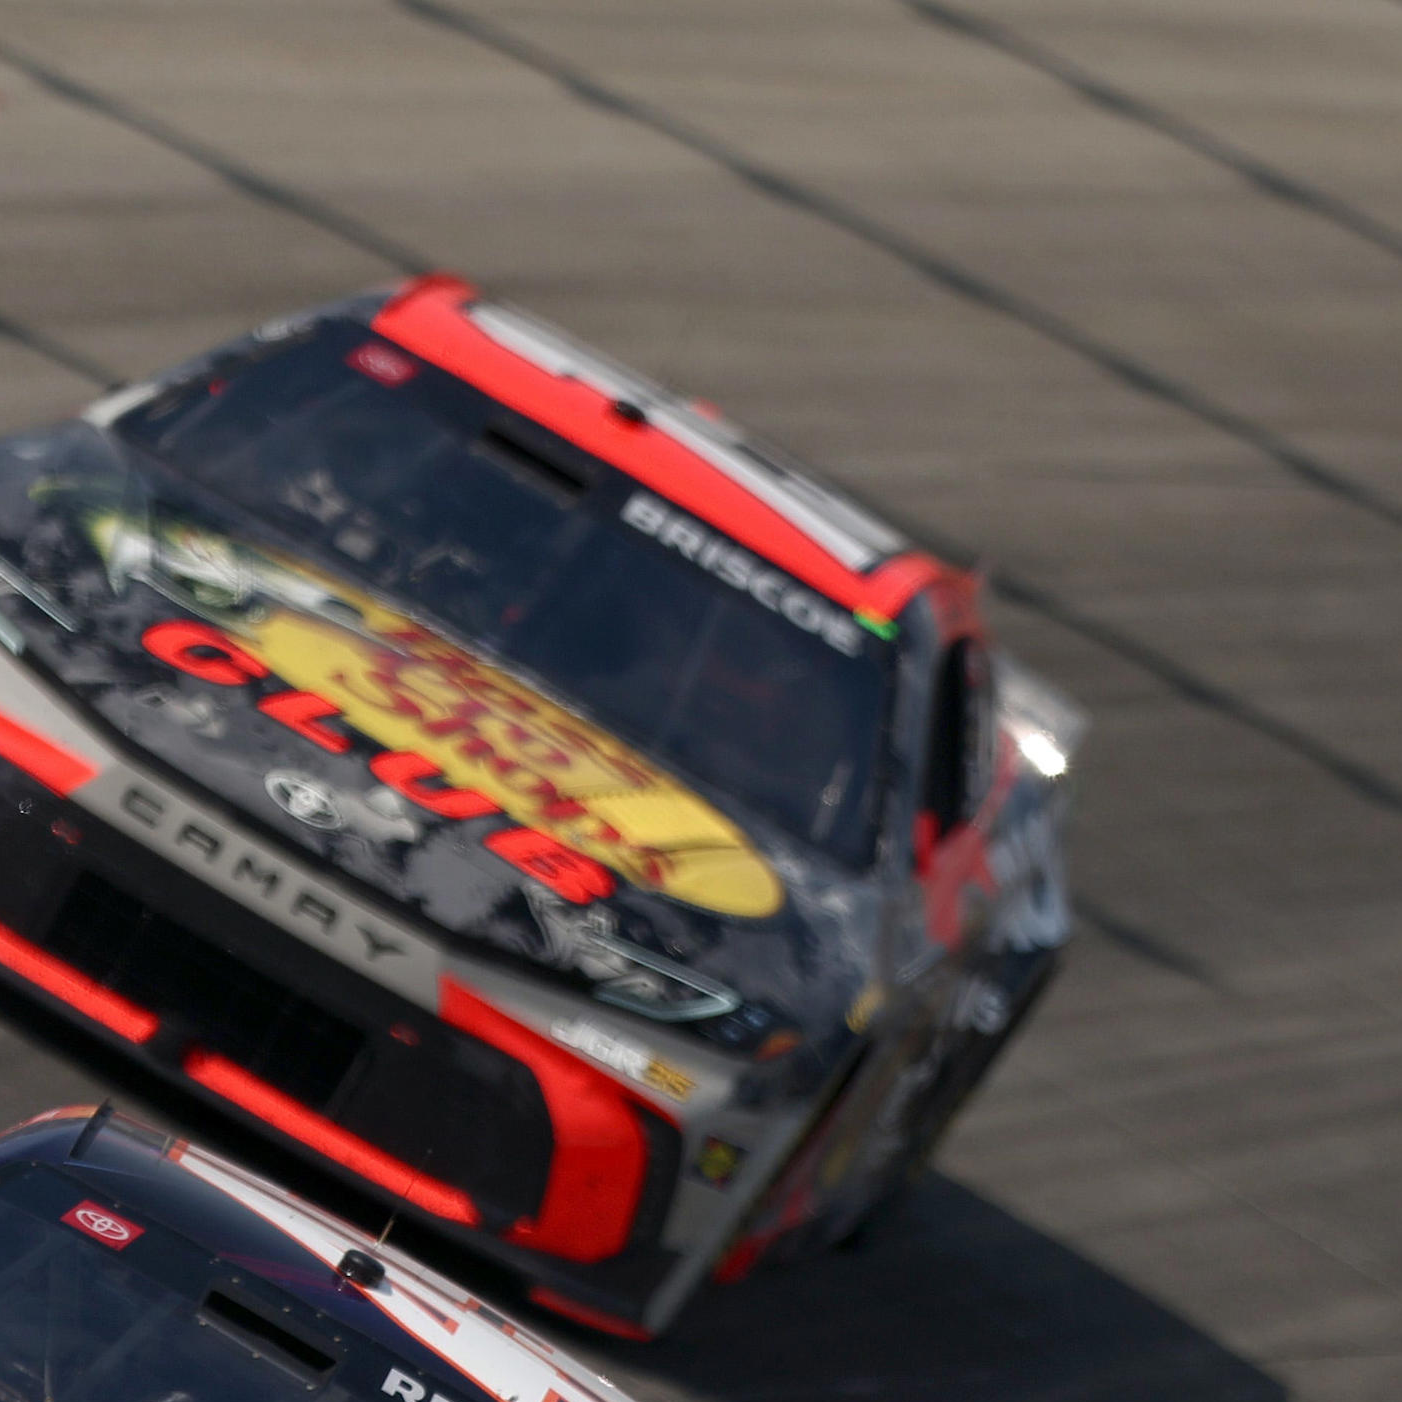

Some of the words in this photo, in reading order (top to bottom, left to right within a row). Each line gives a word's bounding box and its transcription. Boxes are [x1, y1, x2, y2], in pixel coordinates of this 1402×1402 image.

[620, 496, 864, 657] BRISCOE
[141, 620, 616, 904] CLUB
[119, 786, 404, 961] CAMRY
